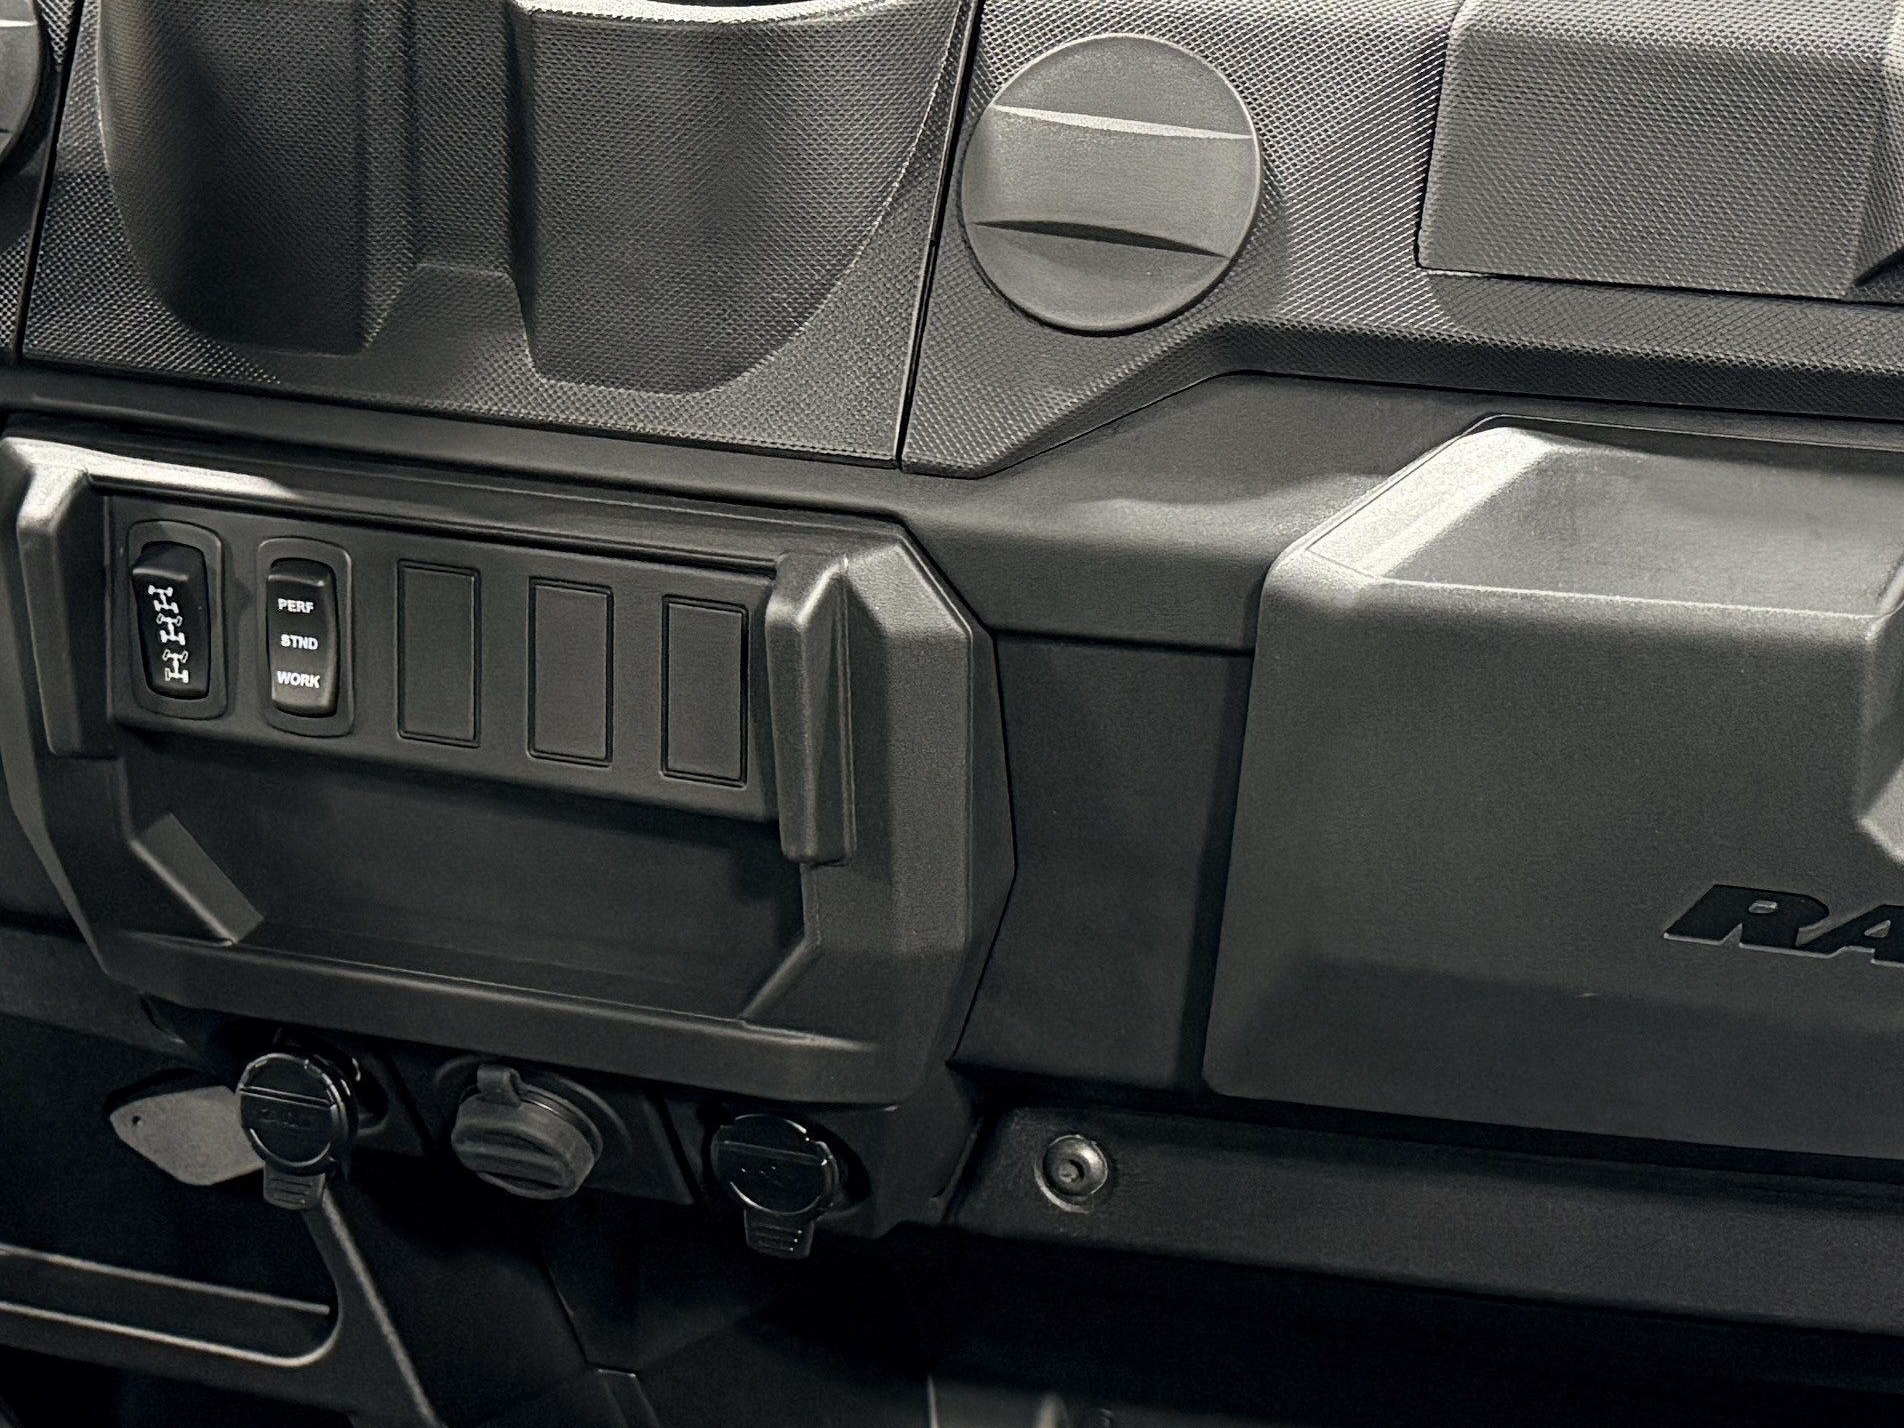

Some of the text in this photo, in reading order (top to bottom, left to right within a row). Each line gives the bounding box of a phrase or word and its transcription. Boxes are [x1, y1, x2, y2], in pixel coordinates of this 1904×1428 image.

[278, 598, 314, 613] PERF
[281, 634, 319, 650] STND
[277, 671, 321, 689] WORK
